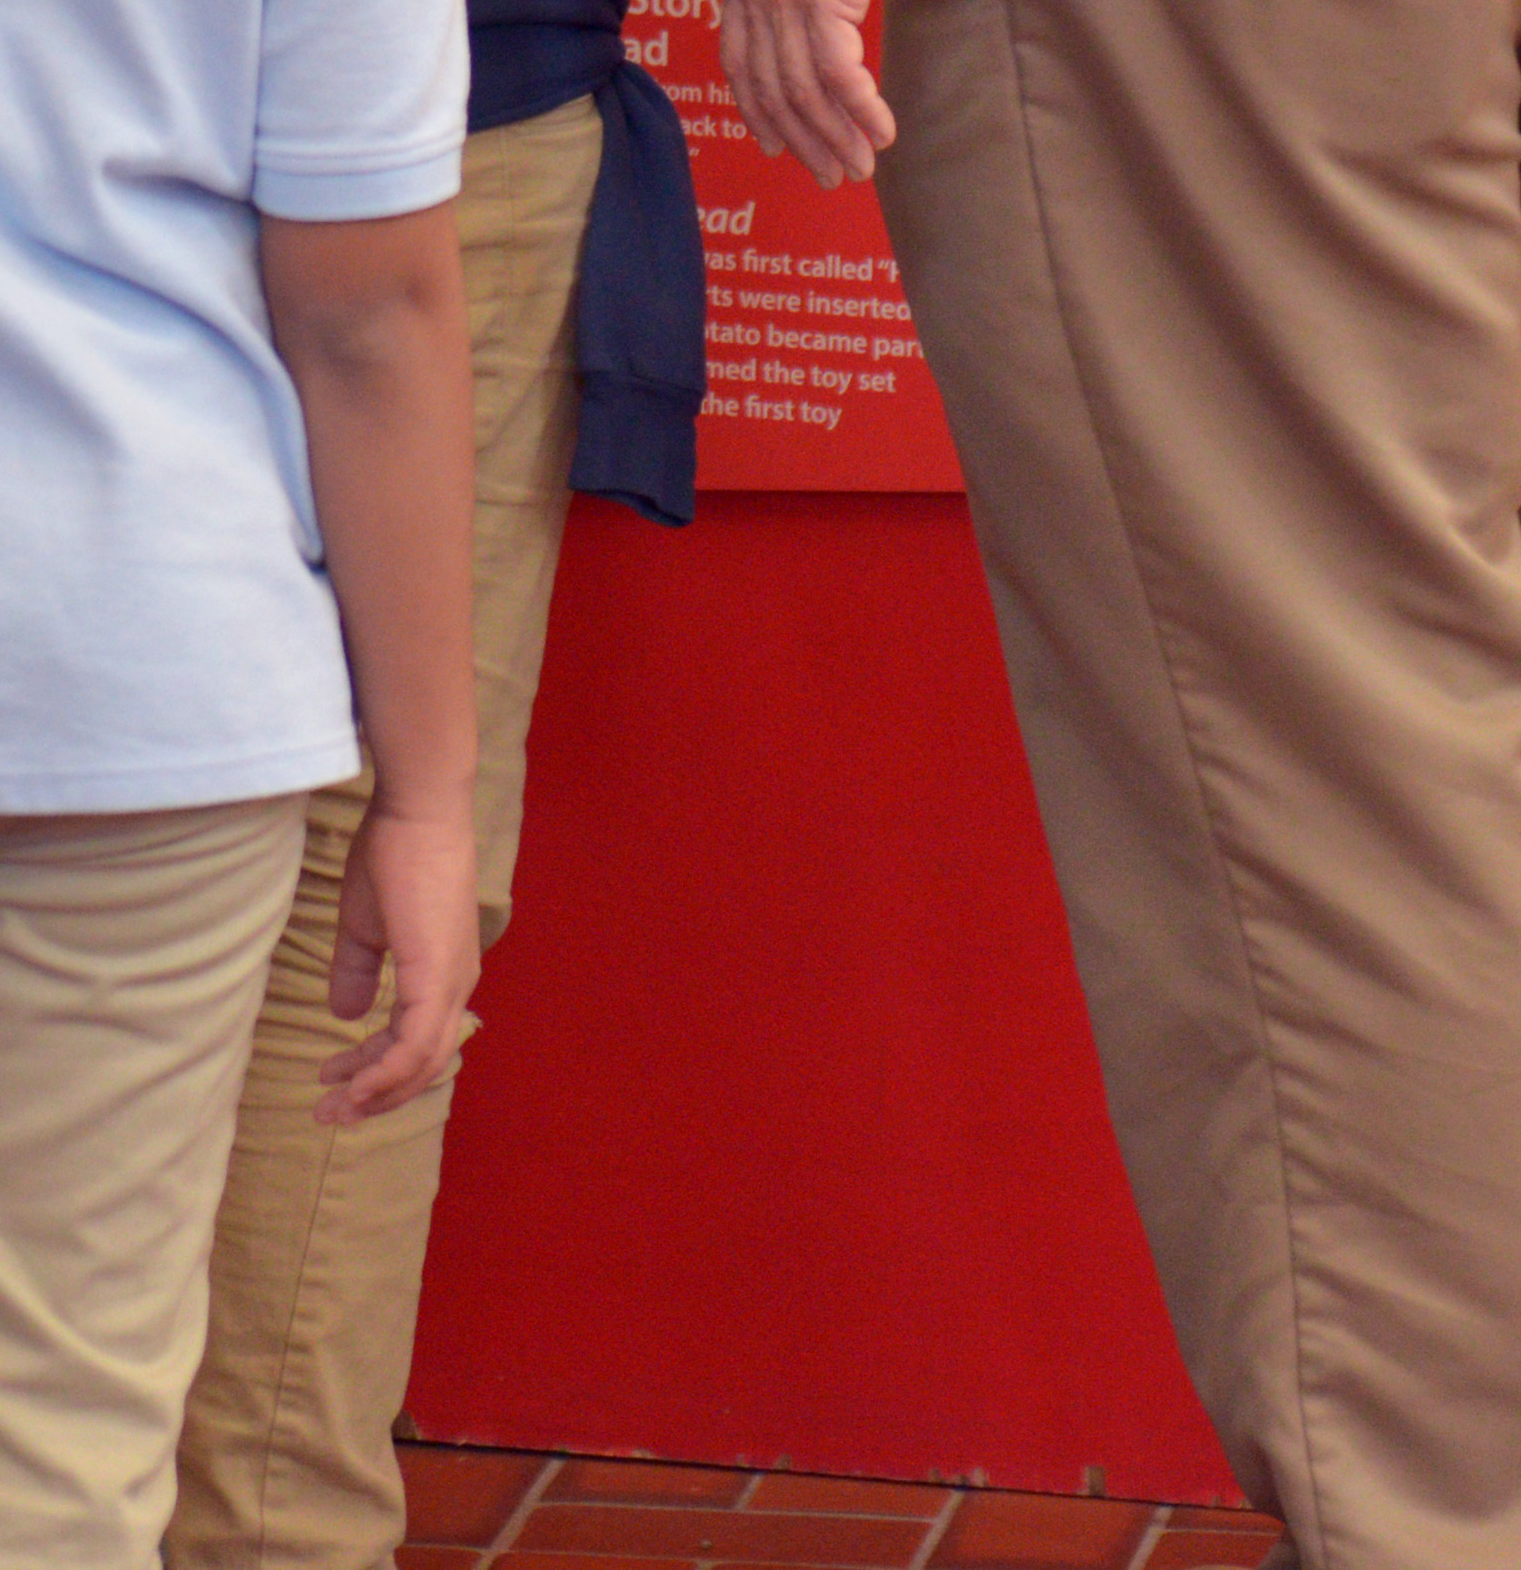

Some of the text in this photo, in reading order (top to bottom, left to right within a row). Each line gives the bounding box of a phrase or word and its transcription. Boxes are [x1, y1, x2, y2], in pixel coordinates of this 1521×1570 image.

[624, 31, 669, 66] ad
[662, 82, 737, 106] om hi
[681, 116, 747, 139] ack to
[705, 252, 737, 271] as
[743, 248, 792, 276] first
[797, 255, 874, 281] called
[706, 286, 733, 308] ts
[740, 291, 802, 313] were
[705, 322, 761, 346] tato
[767, 324, 868, 354] became
[706, 359, 897, 395] med the toy set
[745, 394, 795, 422] first
[801, 402, 843, 431] toy
